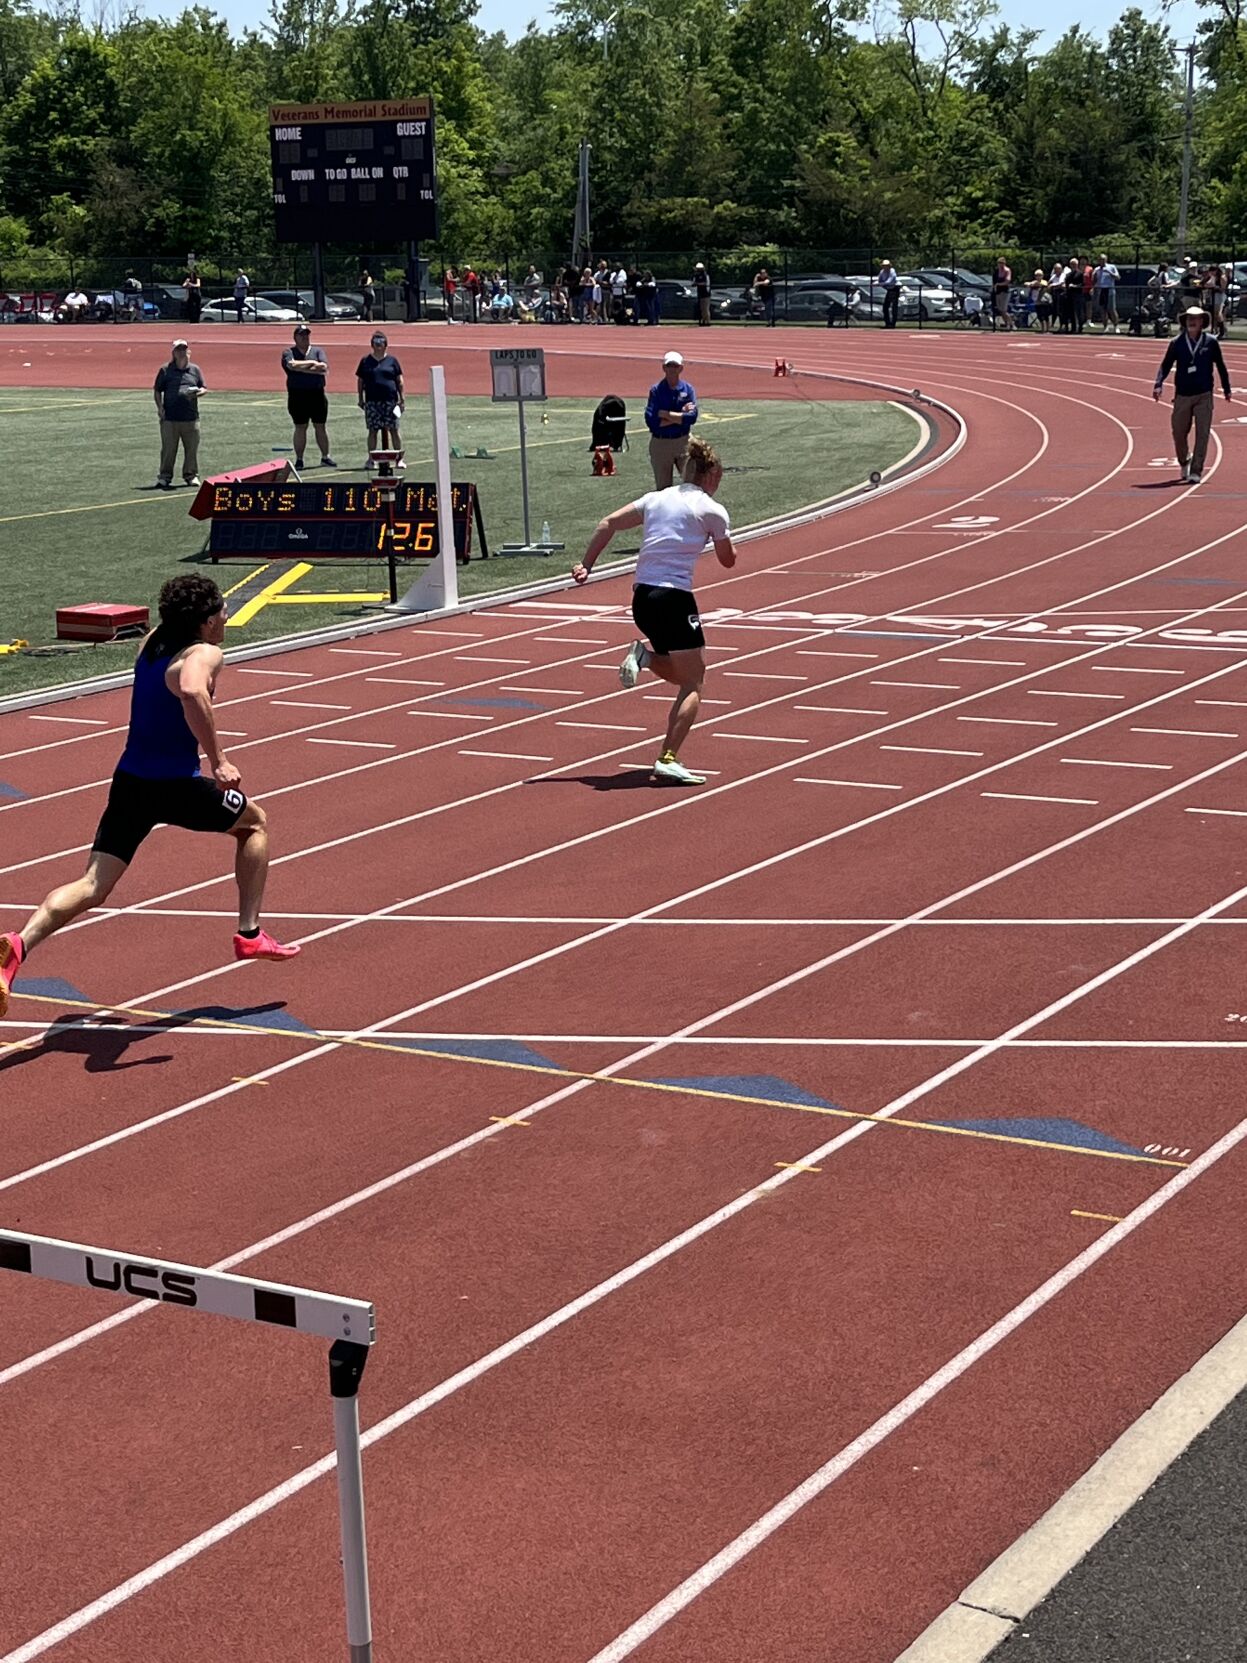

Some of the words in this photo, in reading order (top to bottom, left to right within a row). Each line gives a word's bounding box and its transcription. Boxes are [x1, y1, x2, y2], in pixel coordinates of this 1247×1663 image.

[272, 109, 320, 122] Veterans
[324, 105, 377, 119] Memorial
[381, 103, 427, 117] Stadium
[275, 127, 302, 141] HOME
[396, 122, 427, 136] GUEST
[291, 169, 315, 181] DOWN
[325, 168, 335, 180] TO
[336, 168, 348, 180] GO
[351, 168, 370, 179] BALL
[372, 167, 384, 178] ON
[393, 166, 409, 178] QTR
[495, 350, 514, 359] LAPS
[514, 350, 525, 359] TO
[214, 487, 295, 511] Boys
[323, 487, 382, 512] 110
[226, 790, 241, 809] 6
[85, 1255, 198, 1307] UCS
